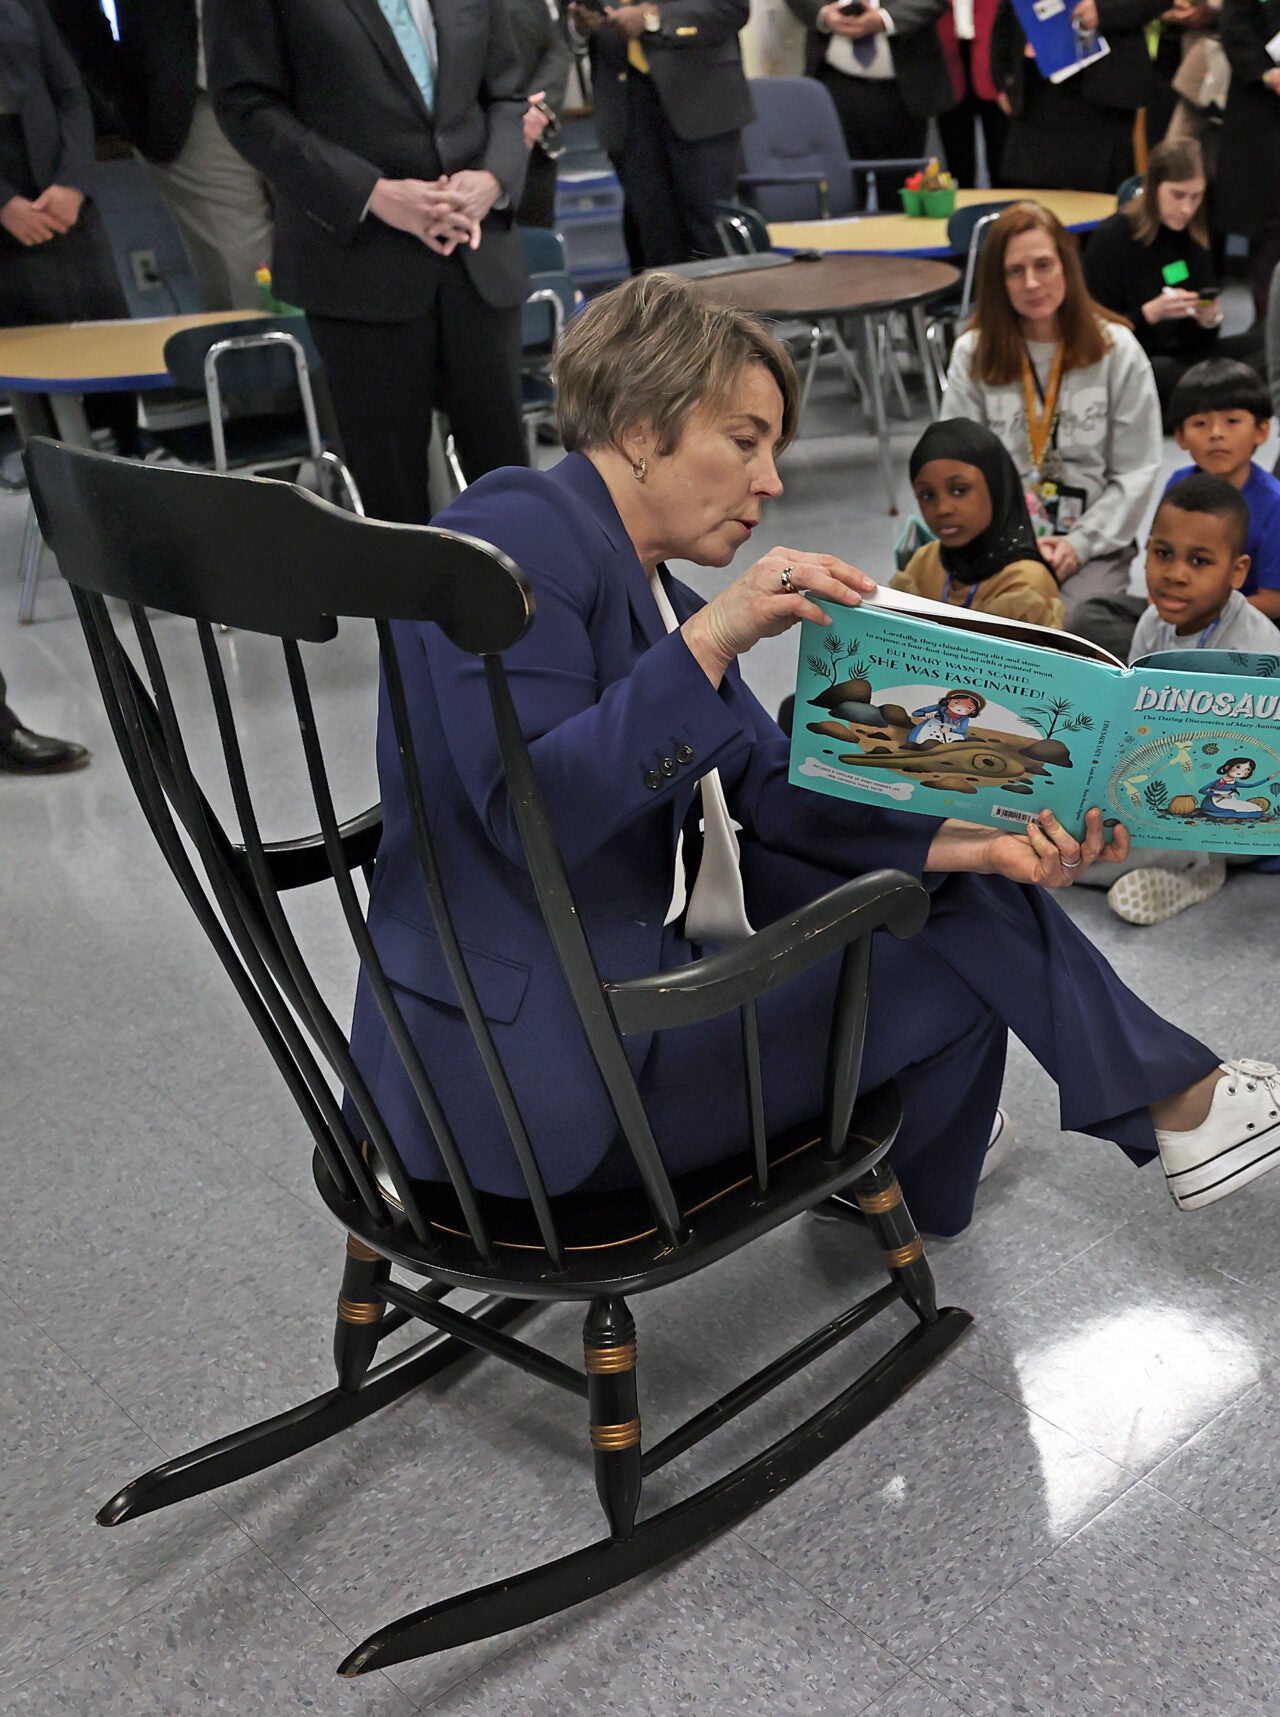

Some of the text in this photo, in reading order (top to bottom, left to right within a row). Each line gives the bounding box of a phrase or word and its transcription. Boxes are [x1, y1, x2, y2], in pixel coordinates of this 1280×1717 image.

[875, 635, 900, 645] expose
[883, 629, 919, 643] Carefully,
[920, 638, 937, 647] they
[886, 647, 1031, 685] BUT MARY WASN'T SCARED.
[868, 654, 1045, 699] SHE WAS FASCINATED!
[1158, 715, 1183, 723] Daring
[1185, 717, 1225, 727] Discoveries
[1234, 721, 1253, 729] Mary
